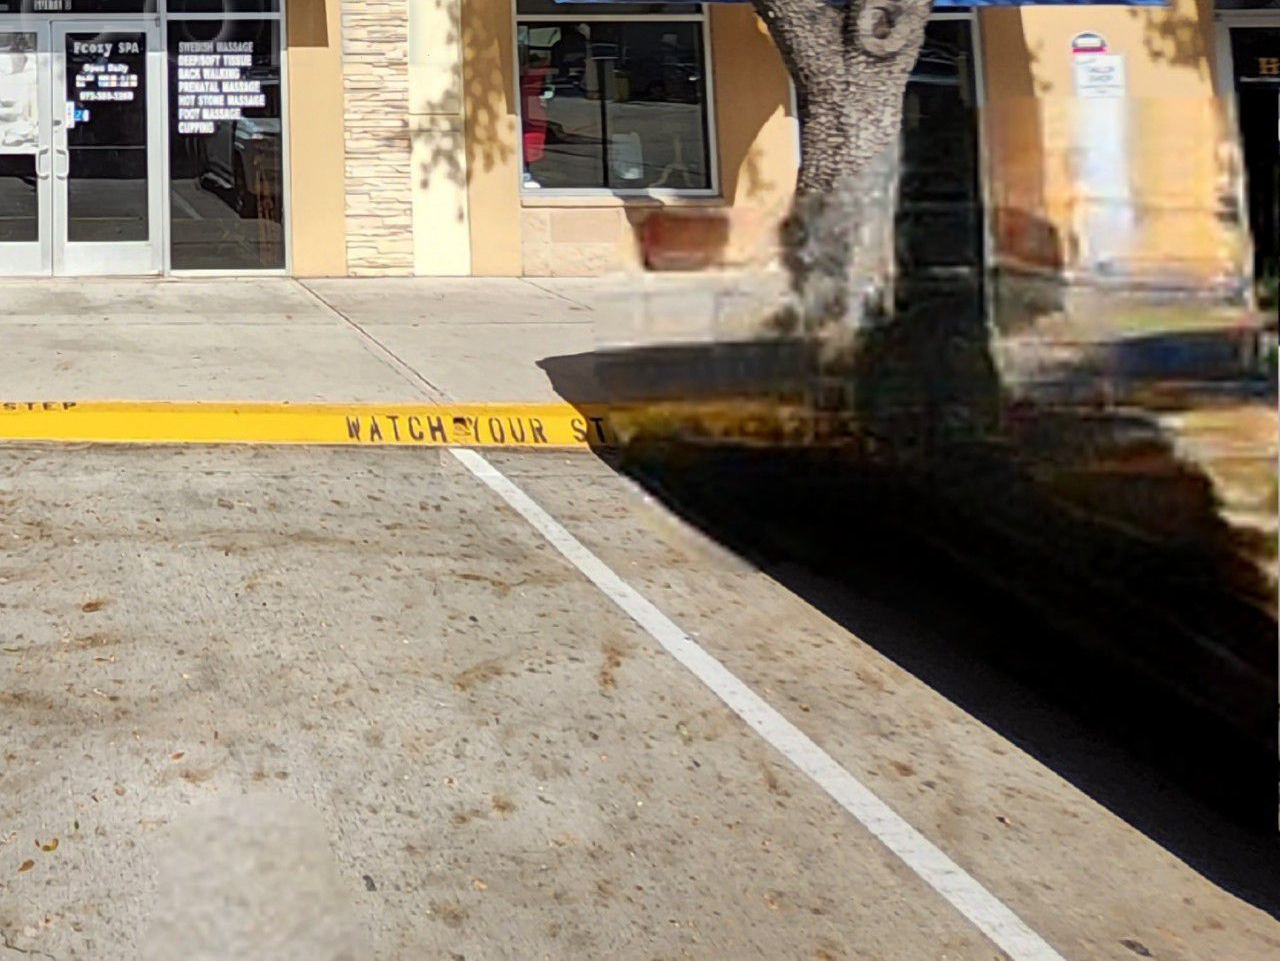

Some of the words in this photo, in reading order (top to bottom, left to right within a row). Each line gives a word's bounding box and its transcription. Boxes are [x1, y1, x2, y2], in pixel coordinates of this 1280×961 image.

[73, 42, 112, 57] Fcozy
[118, 42, 139, 54] SPA
[178, 41, 214, 53] SWEDISH
[216, 41, 253, 53] MASSAGE
[223, 54, 252, 66] TISSUE
[178, 68, 201, 80] BACK
[202, 68, 240, 80] WALKING
[178, 80, 219, 93] PRENATAL
[222, 80, 260, 93] MASSAGE
[178, 94, 195, 107] HOT
[197, 94, 225, 107] STONE
[227, 94, 265, 107] MASSAGE
[178, 108, 200, 120] FOOT
[202, 108, 241, 120] MASSAGE
[3, 402, 78, 412] STEP
[346, 415, 448, 443] WATCH
[469, 417, 548, 444] YOUR
[571, 418, 606, 444] ST
